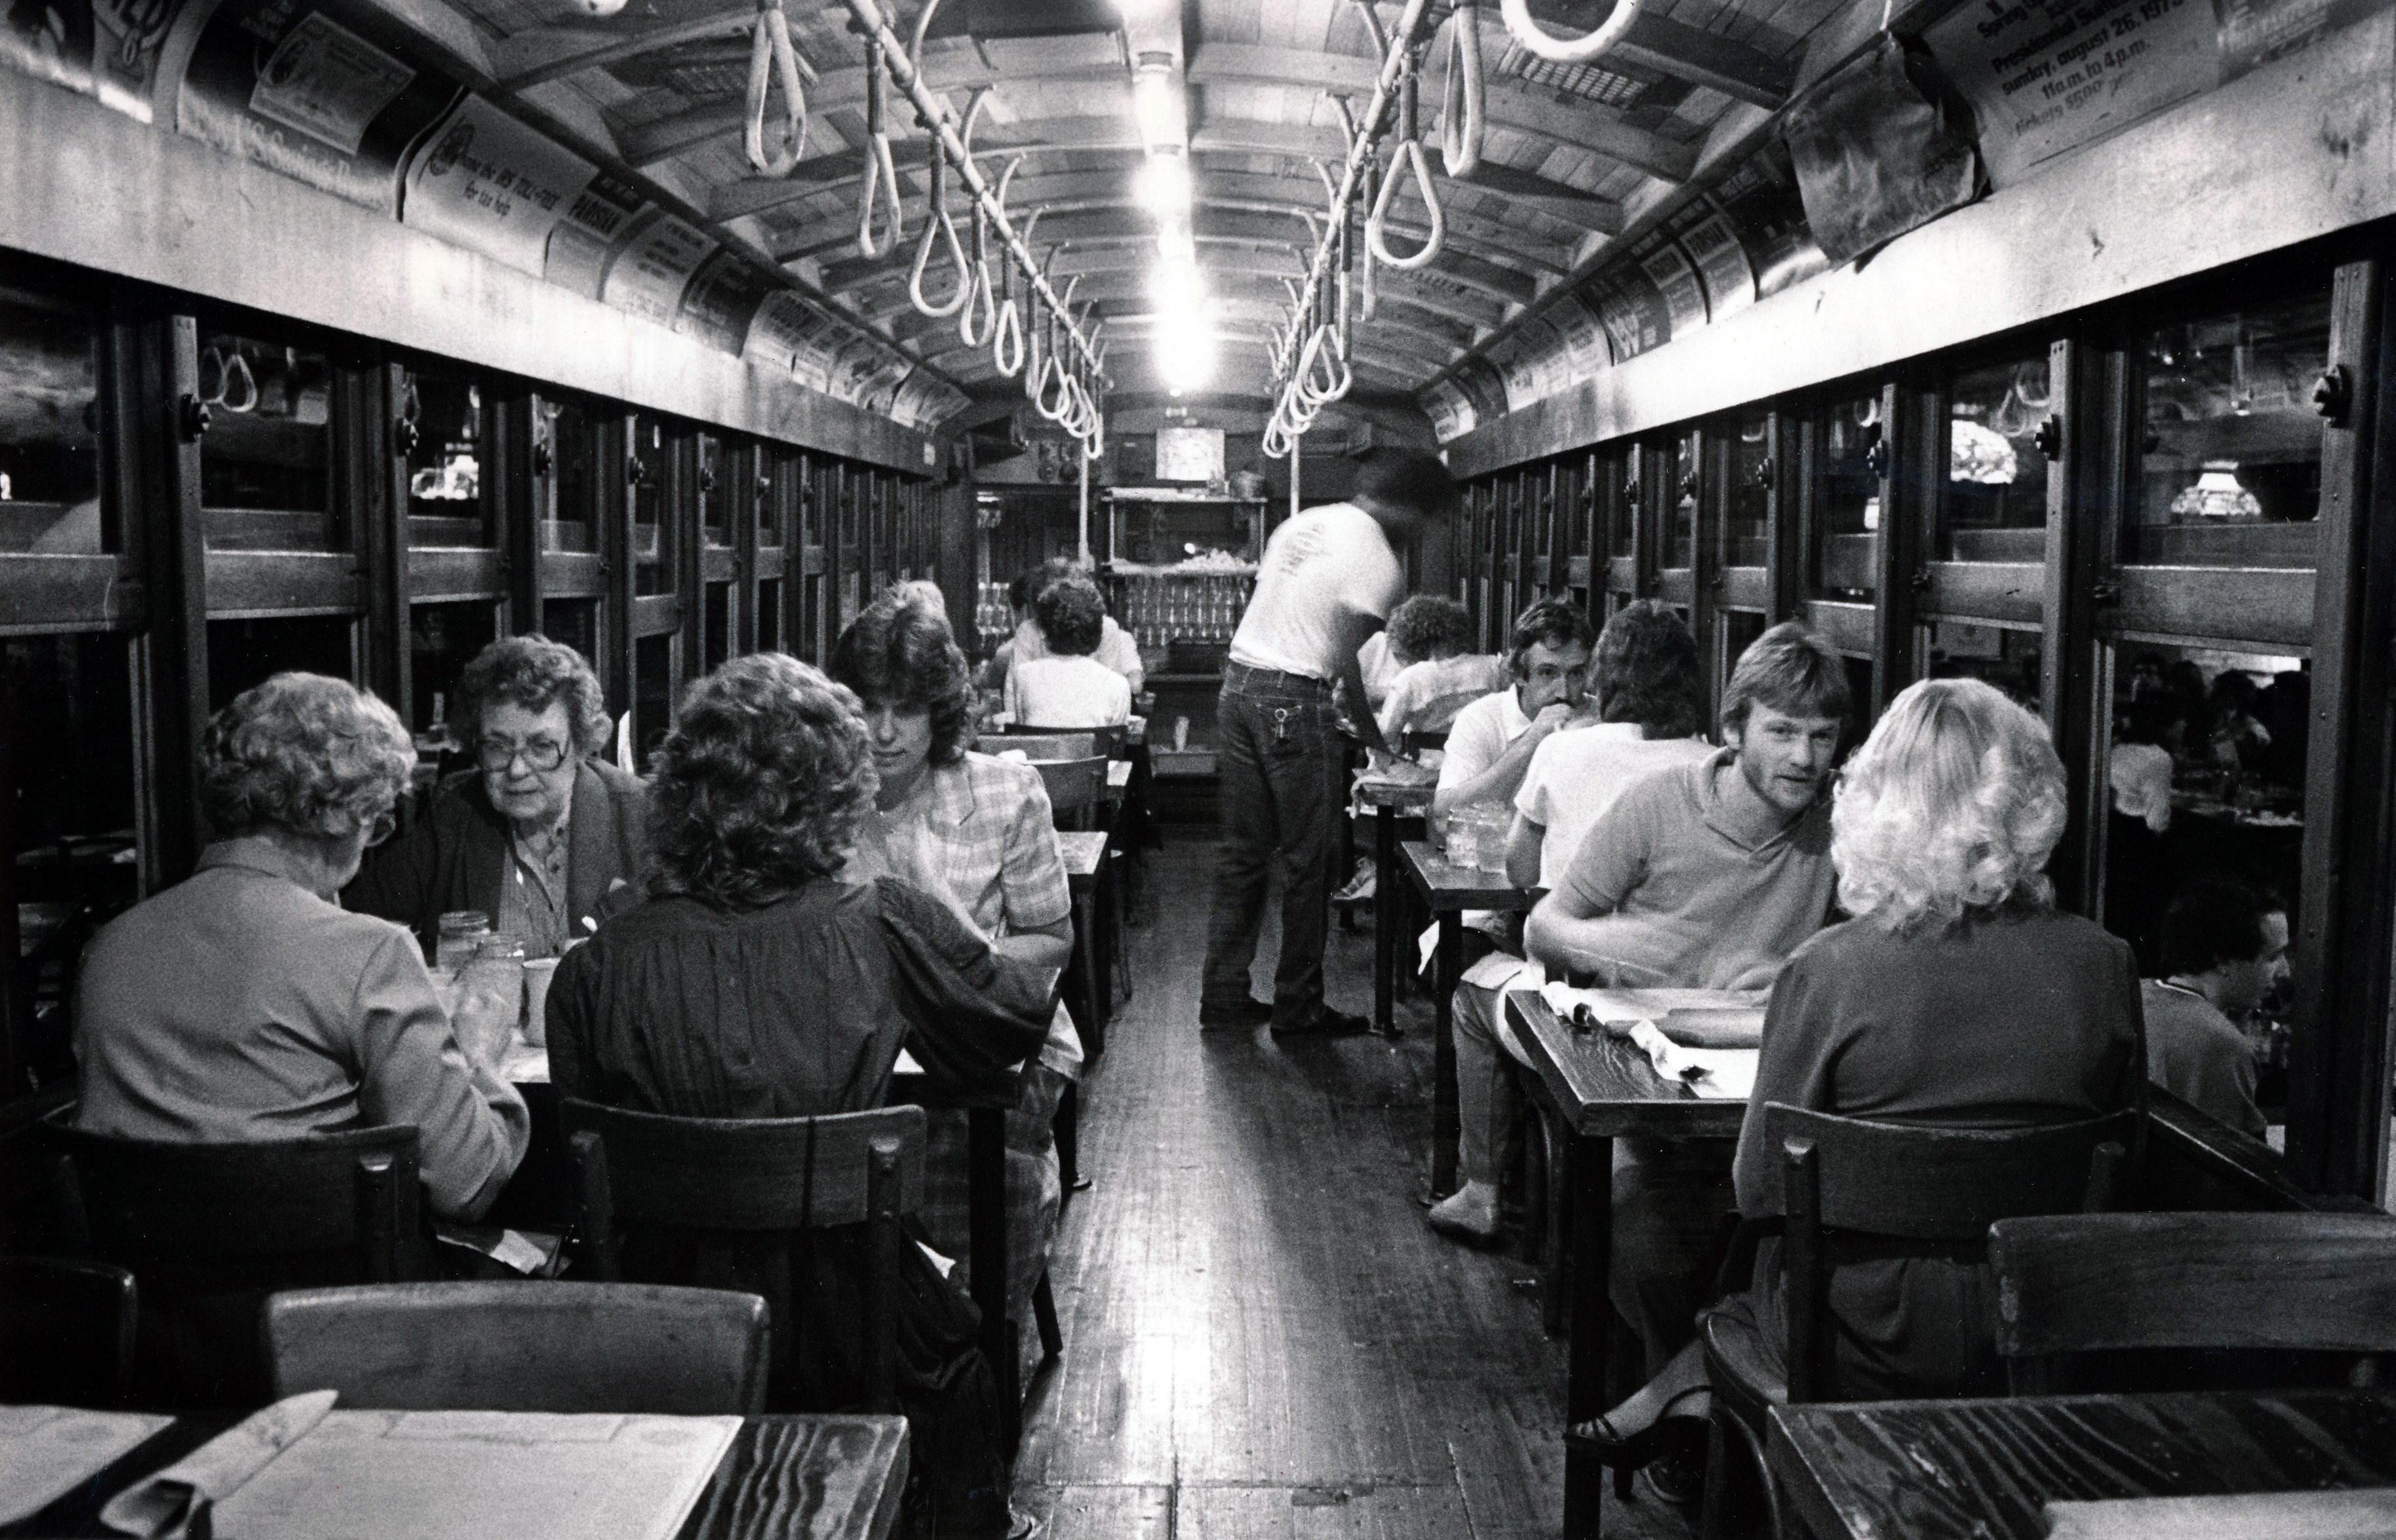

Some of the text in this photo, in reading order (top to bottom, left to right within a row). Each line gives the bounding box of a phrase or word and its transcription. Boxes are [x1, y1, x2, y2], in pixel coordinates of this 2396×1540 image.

[1977, 6, 2028, 38] Spring
[1991, 16, 2077, 73] Presidential
[2002, 60, 2056, 96] sunday,
[2057, 27, 2110, 65] august
[2085, 61, 2103, 79] to
